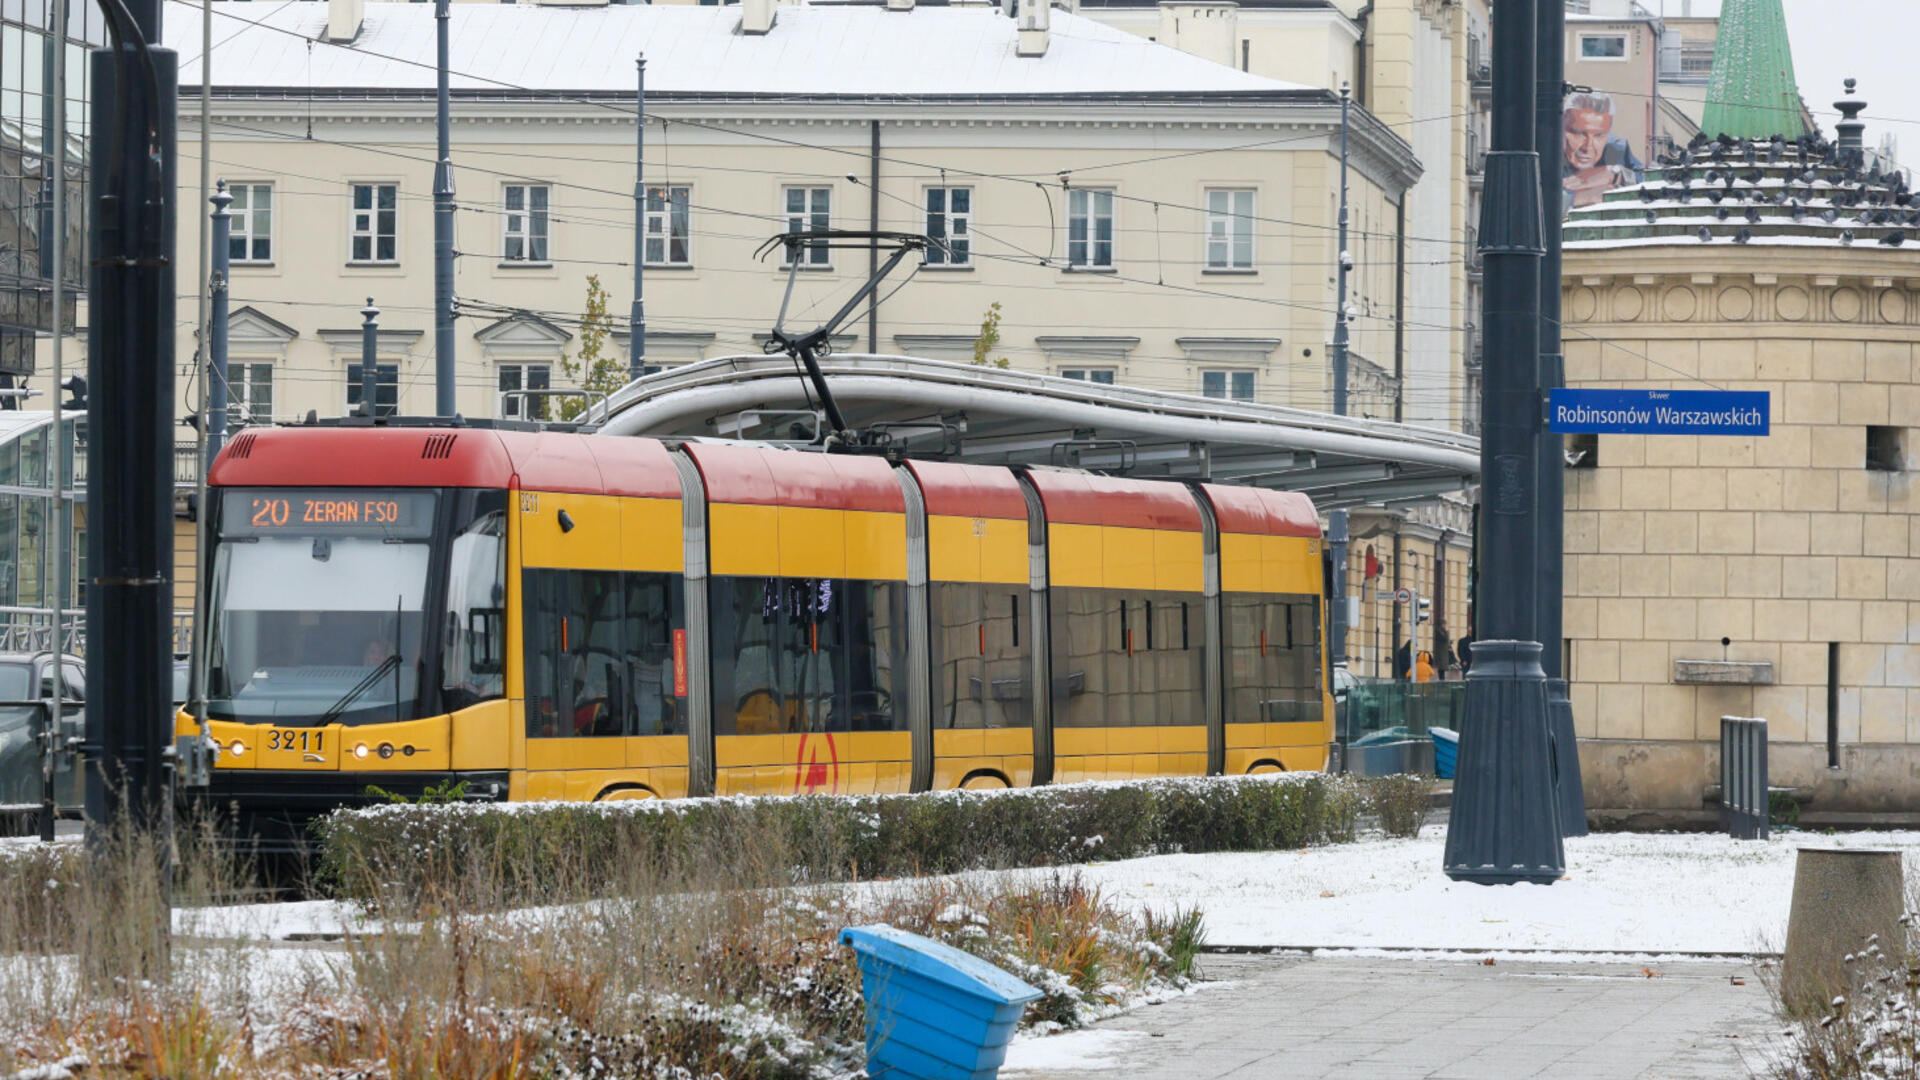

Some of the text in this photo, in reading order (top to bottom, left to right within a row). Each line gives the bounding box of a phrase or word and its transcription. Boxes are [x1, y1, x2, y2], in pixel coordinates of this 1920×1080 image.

[1648, 391, 1670, 400] Skwer
[1557, 405, 1761, 426] Robinsonów Warszawskich
[251, 498, 290, 527] 20
[364, 500, 398, 523] FSO
[267, 730, 323, 752] 3211
